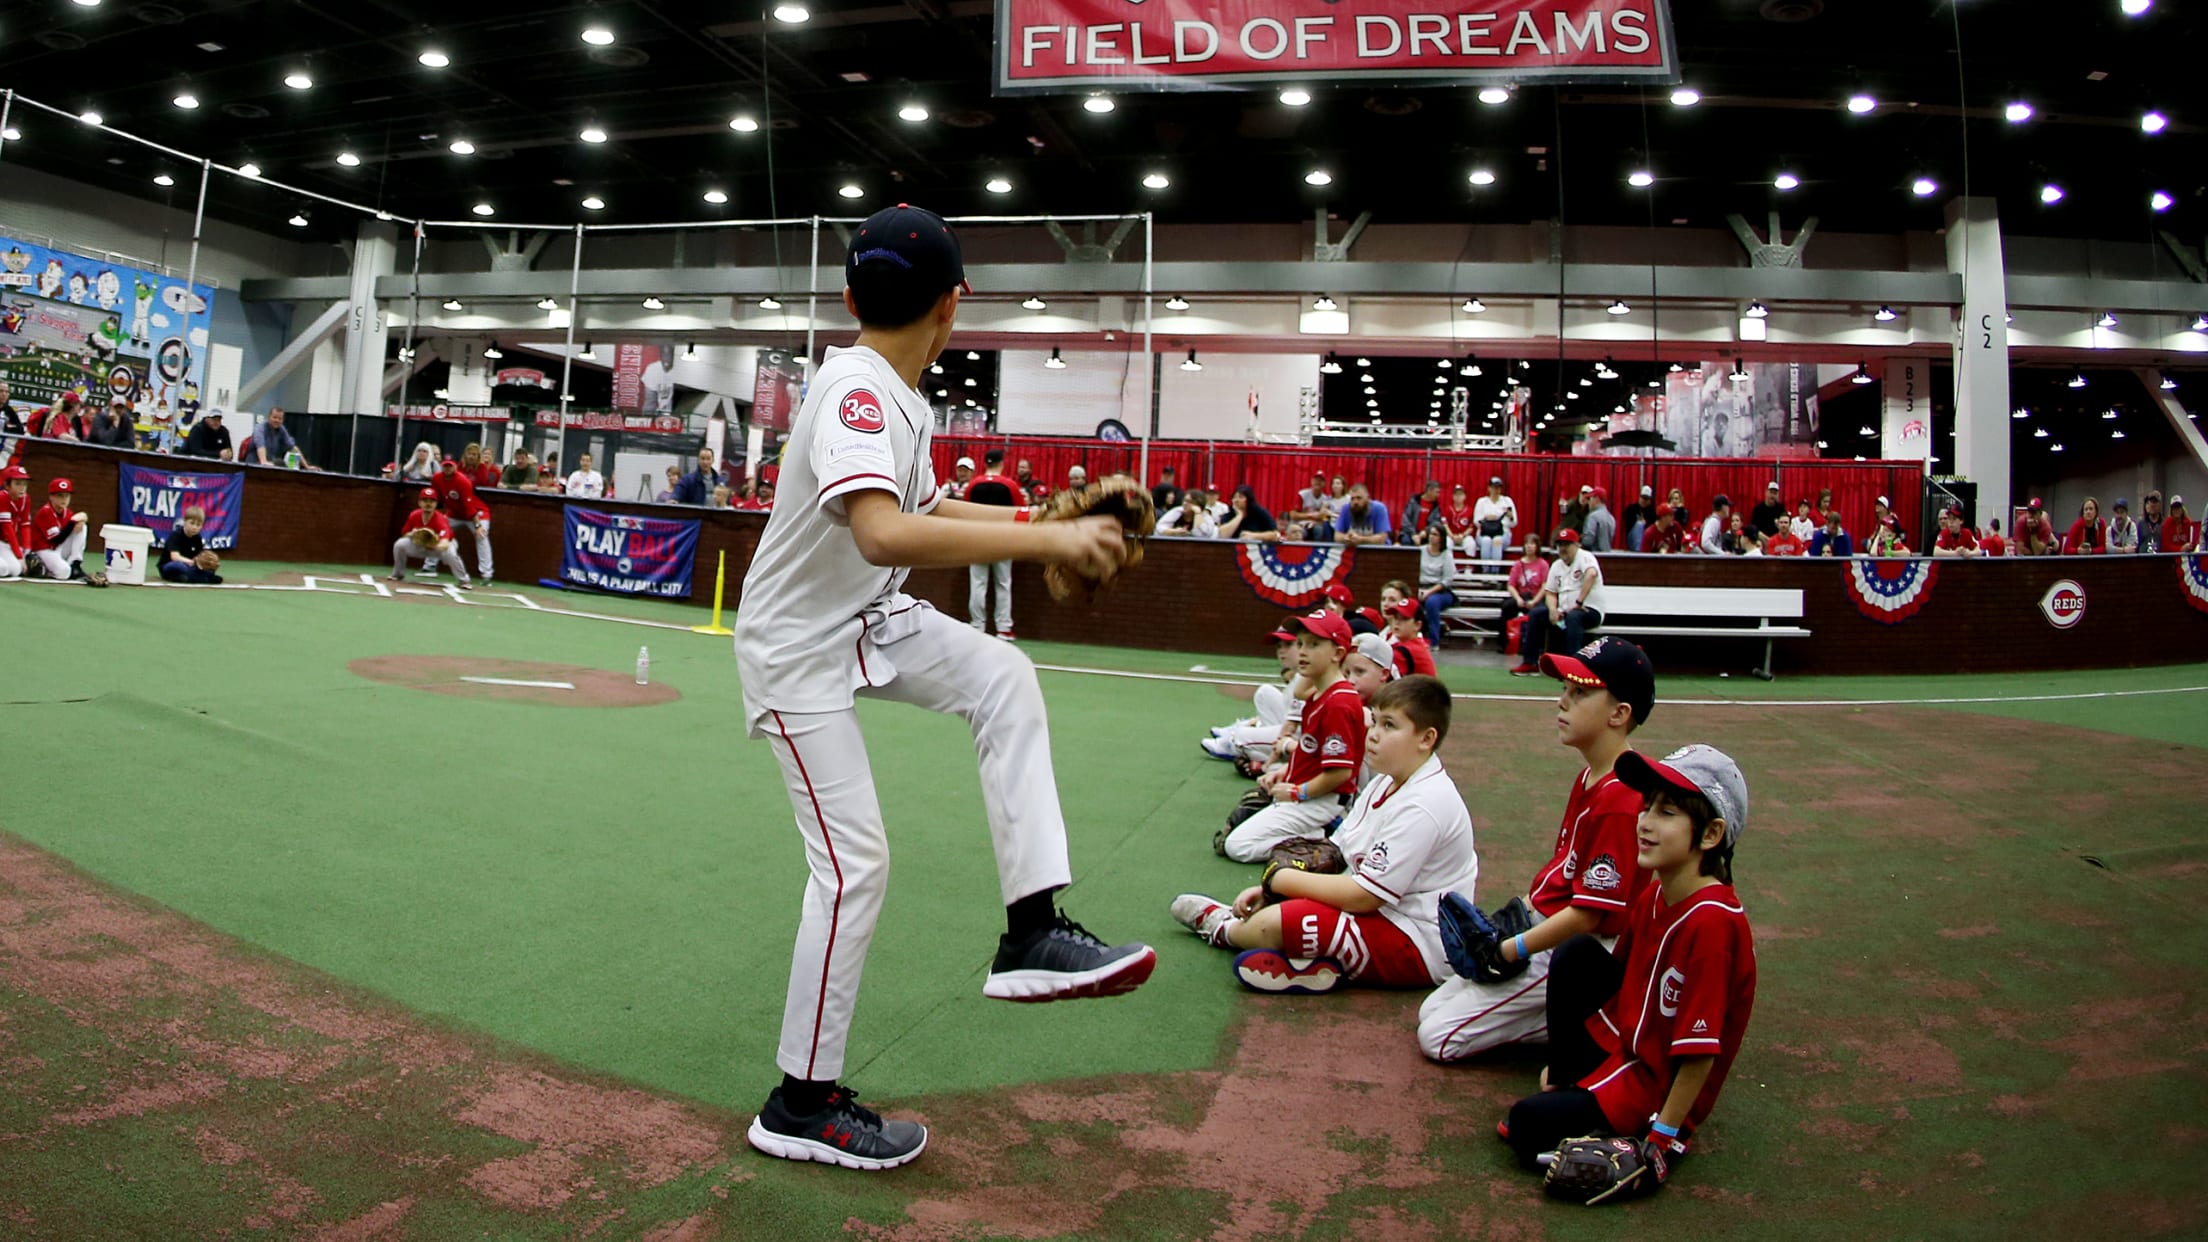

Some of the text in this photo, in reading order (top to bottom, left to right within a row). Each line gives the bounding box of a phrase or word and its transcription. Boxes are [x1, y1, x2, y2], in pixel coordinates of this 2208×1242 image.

[1021, 9, 1651, 67] FIELD OF DREAMS
[132, 485, 181, 518] PLAY
[575, 523, 678, 562] PLAY BALL
[661, 582, 683, 595] CITY
[2053, 598, 2084, 610] REDS
